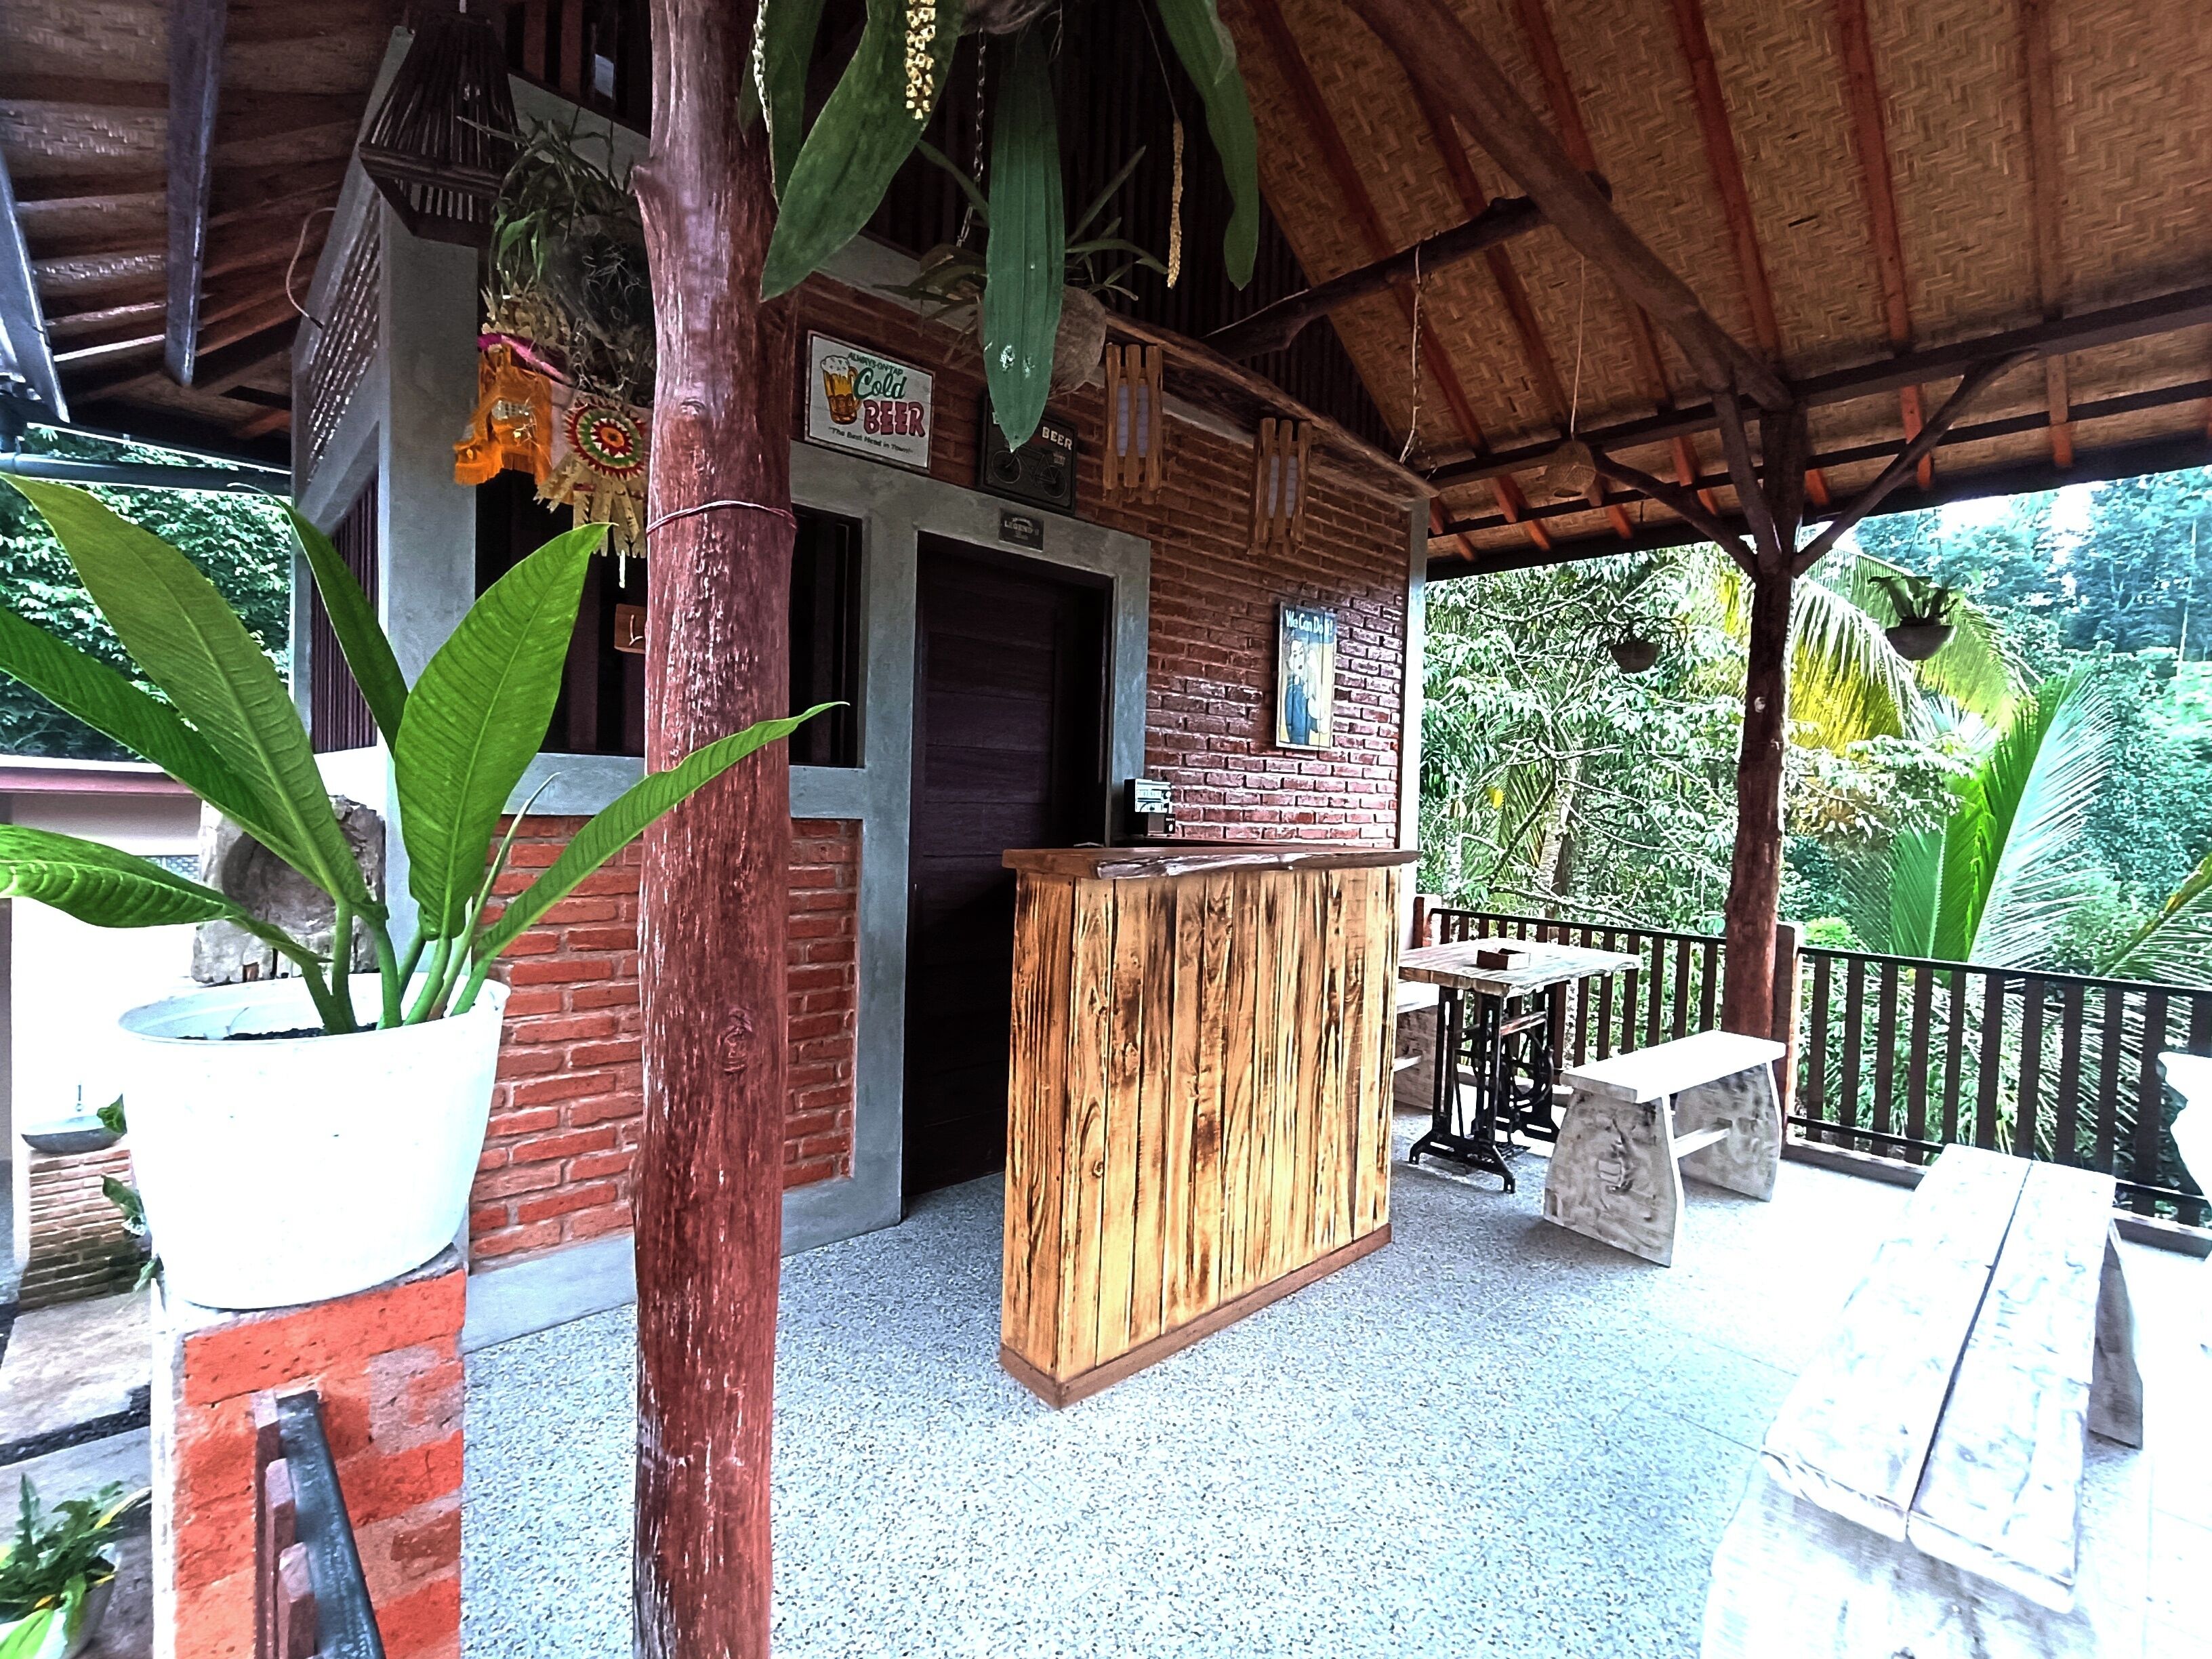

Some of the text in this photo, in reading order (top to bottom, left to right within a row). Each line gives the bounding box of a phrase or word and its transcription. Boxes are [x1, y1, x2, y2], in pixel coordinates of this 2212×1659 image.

[854, 367, 907, 399] Cold
[863, 399, 925, 437] BEER
[847, 432, 862, 441] Best
[1042, 426, 1072, 450] BEER
[1286, 610, 1298, 628] We
[1299, 613, 1312, 632] Can
[1313, 616, 1323, 634] Do
